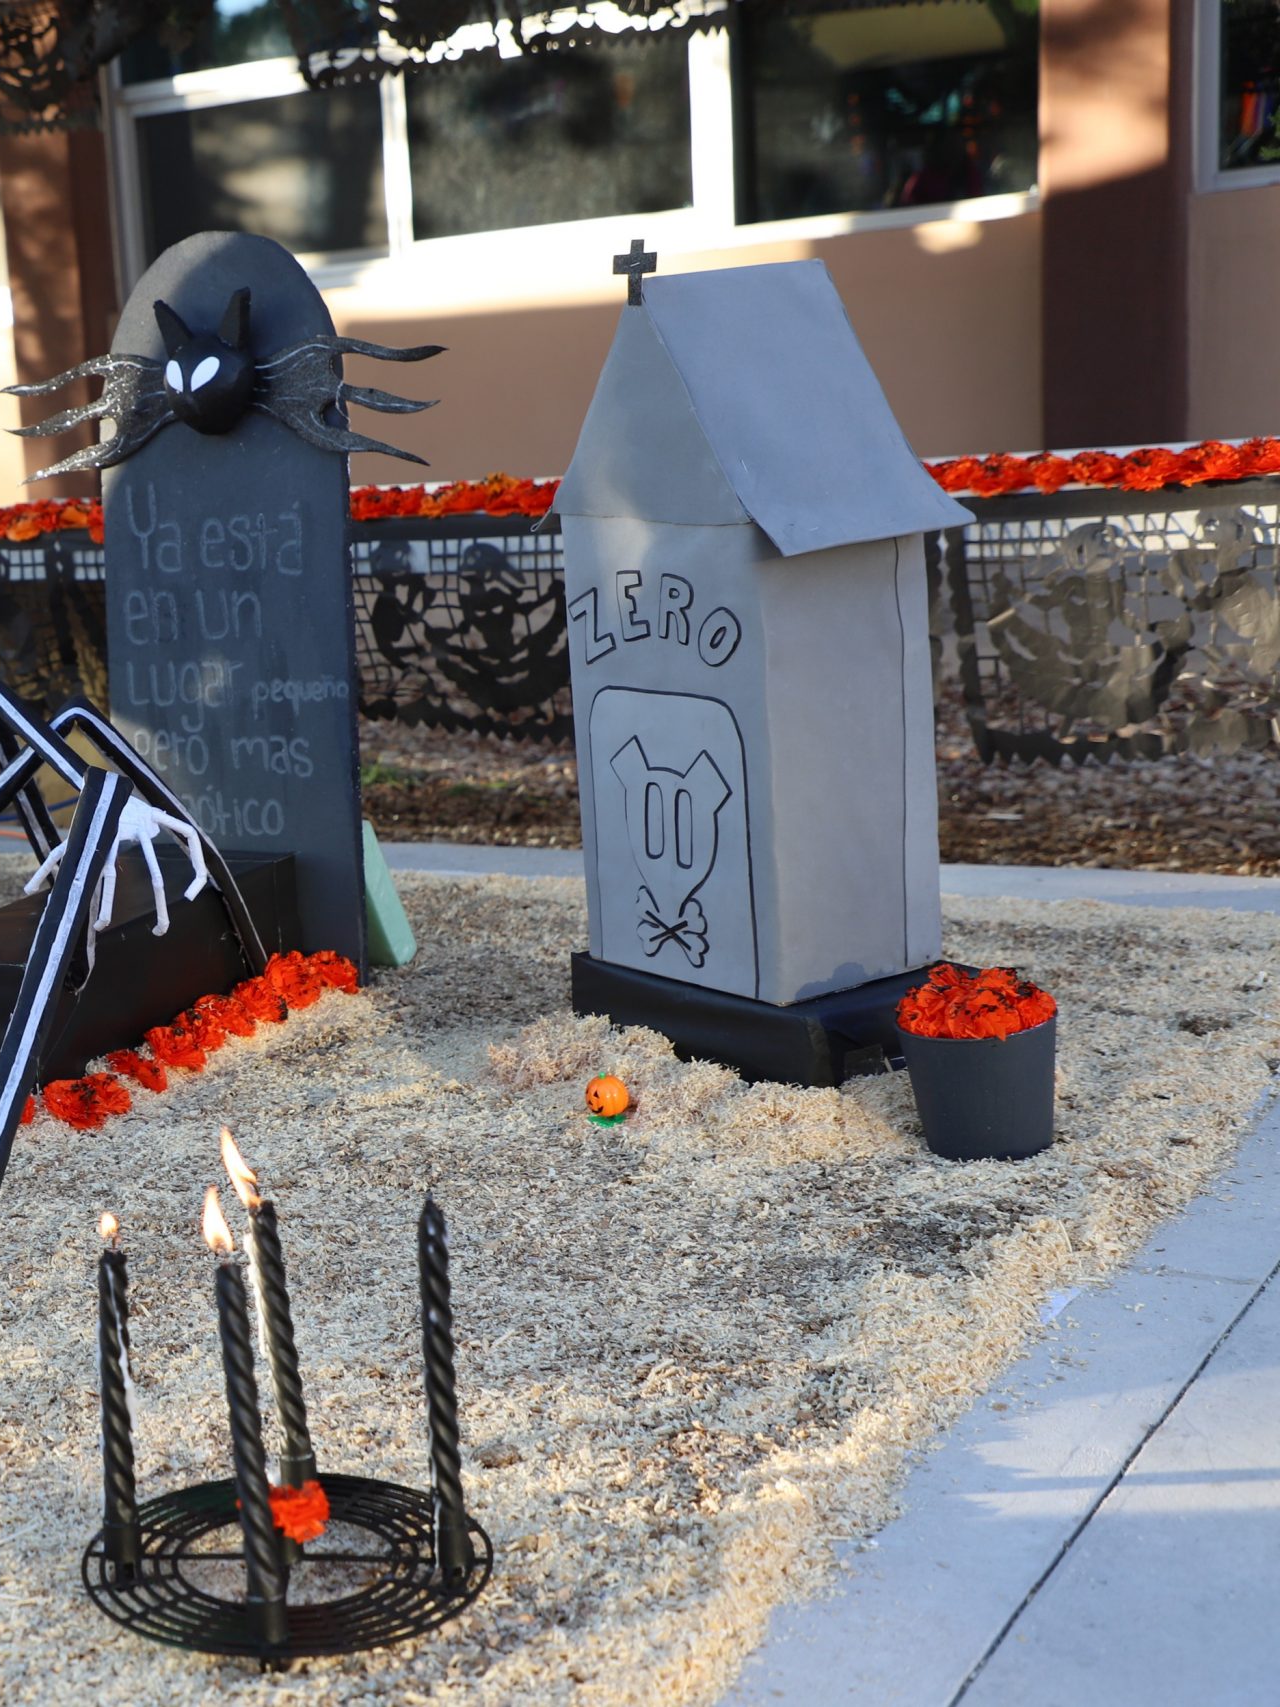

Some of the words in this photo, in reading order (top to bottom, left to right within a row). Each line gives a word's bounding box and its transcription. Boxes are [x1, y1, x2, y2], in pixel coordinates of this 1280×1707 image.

[125, 481, 182, 573] Ya
[199, 501, 303, 576] está
[123, 587, 178, 646] en
[568, 569, 742, 667] ZERO
[251, 673, 349, 720] pequeño
[231, 735, 314, 777] mas
[181, 784, 285, 836] ótico
